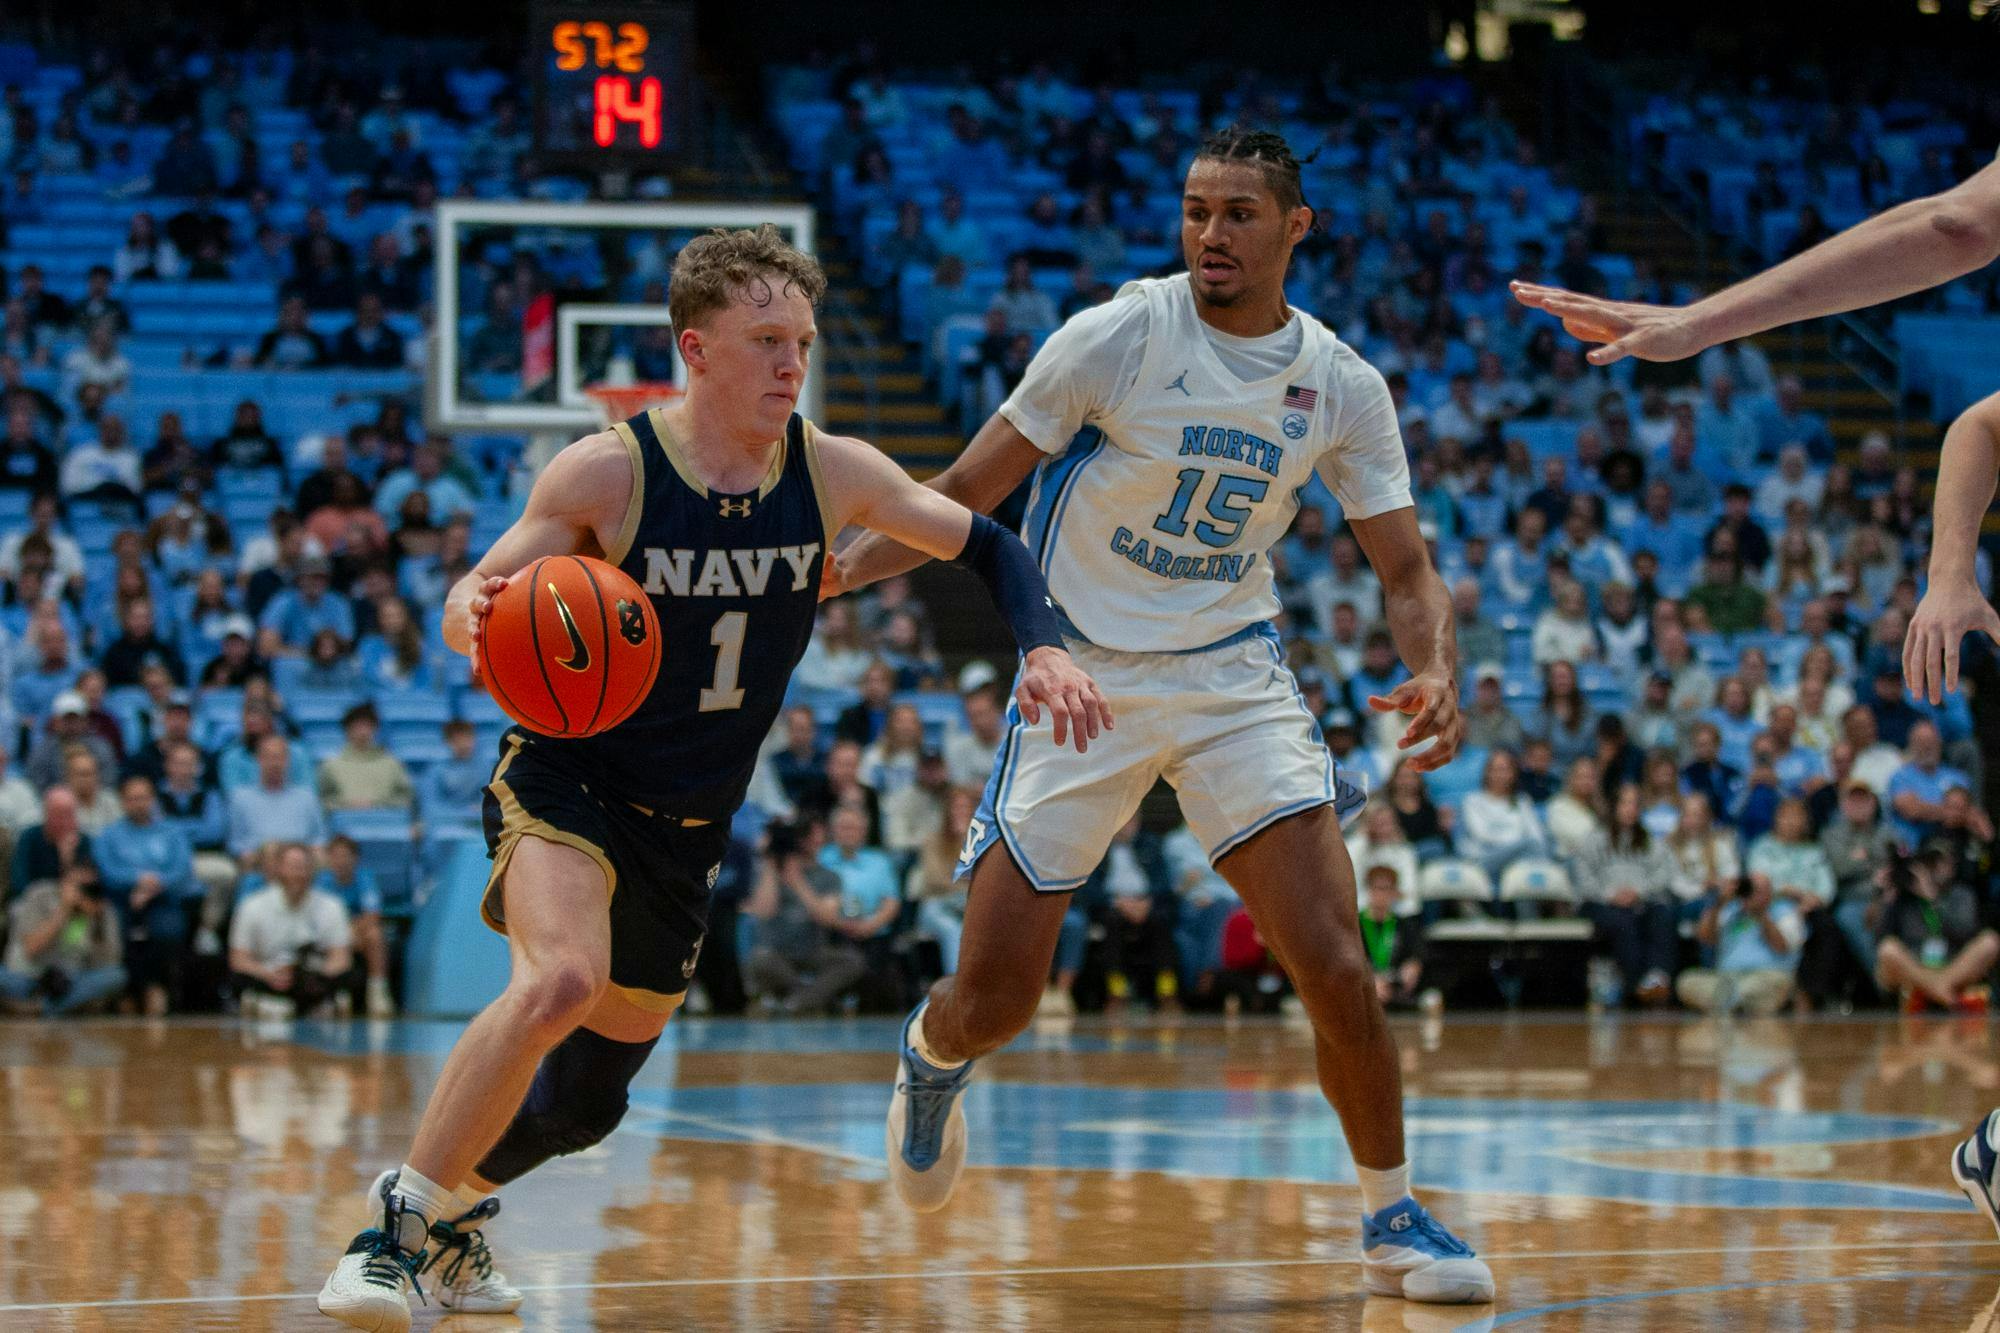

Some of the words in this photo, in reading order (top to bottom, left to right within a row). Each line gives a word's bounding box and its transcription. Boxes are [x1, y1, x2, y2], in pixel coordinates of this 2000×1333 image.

[594, 75, 662, 148] 14
[1178, 425, 1283, 478] NORTH
[1152, 467, 1270, 549] 15
[642, 543, 820, 597] NAVY
[698, 611, 749, 712] 1
